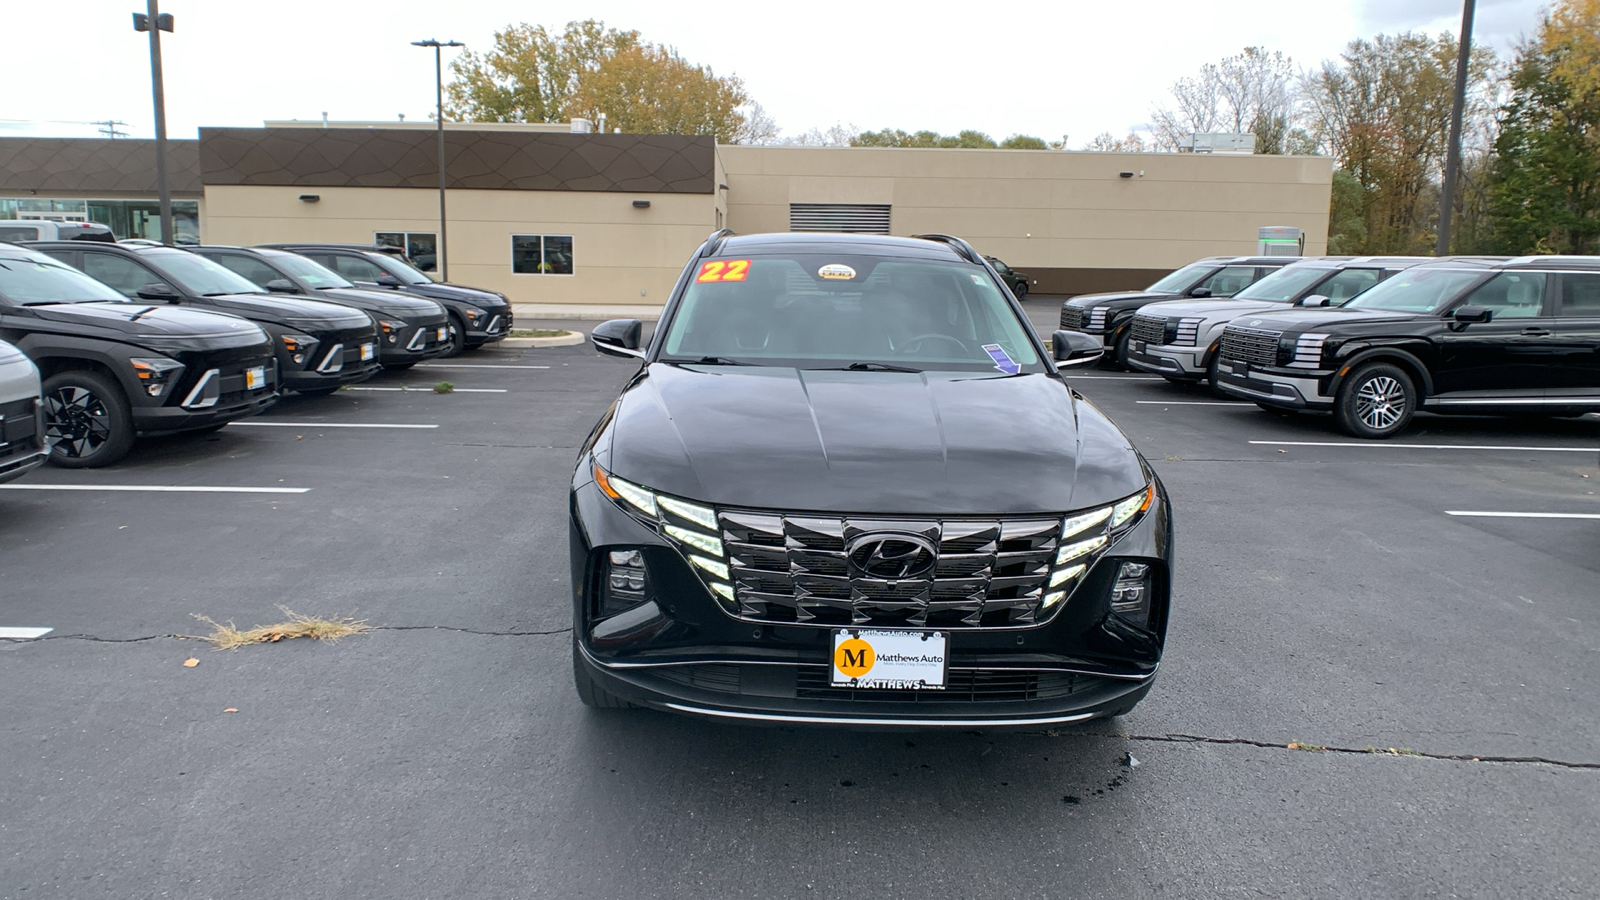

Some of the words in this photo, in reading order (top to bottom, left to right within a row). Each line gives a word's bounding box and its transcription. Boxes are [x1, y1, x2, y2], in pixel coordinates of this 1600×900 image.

[698, 260, 748, 281] 22
[857, 629, 924, 638] MatthewsAuto.com
[841, 648, 867, 667] M
[876, 653, 920, 662] Matthews
[921, 654, 943, 663] Auto
[856, 679, 920, 690] MATTHEWS
